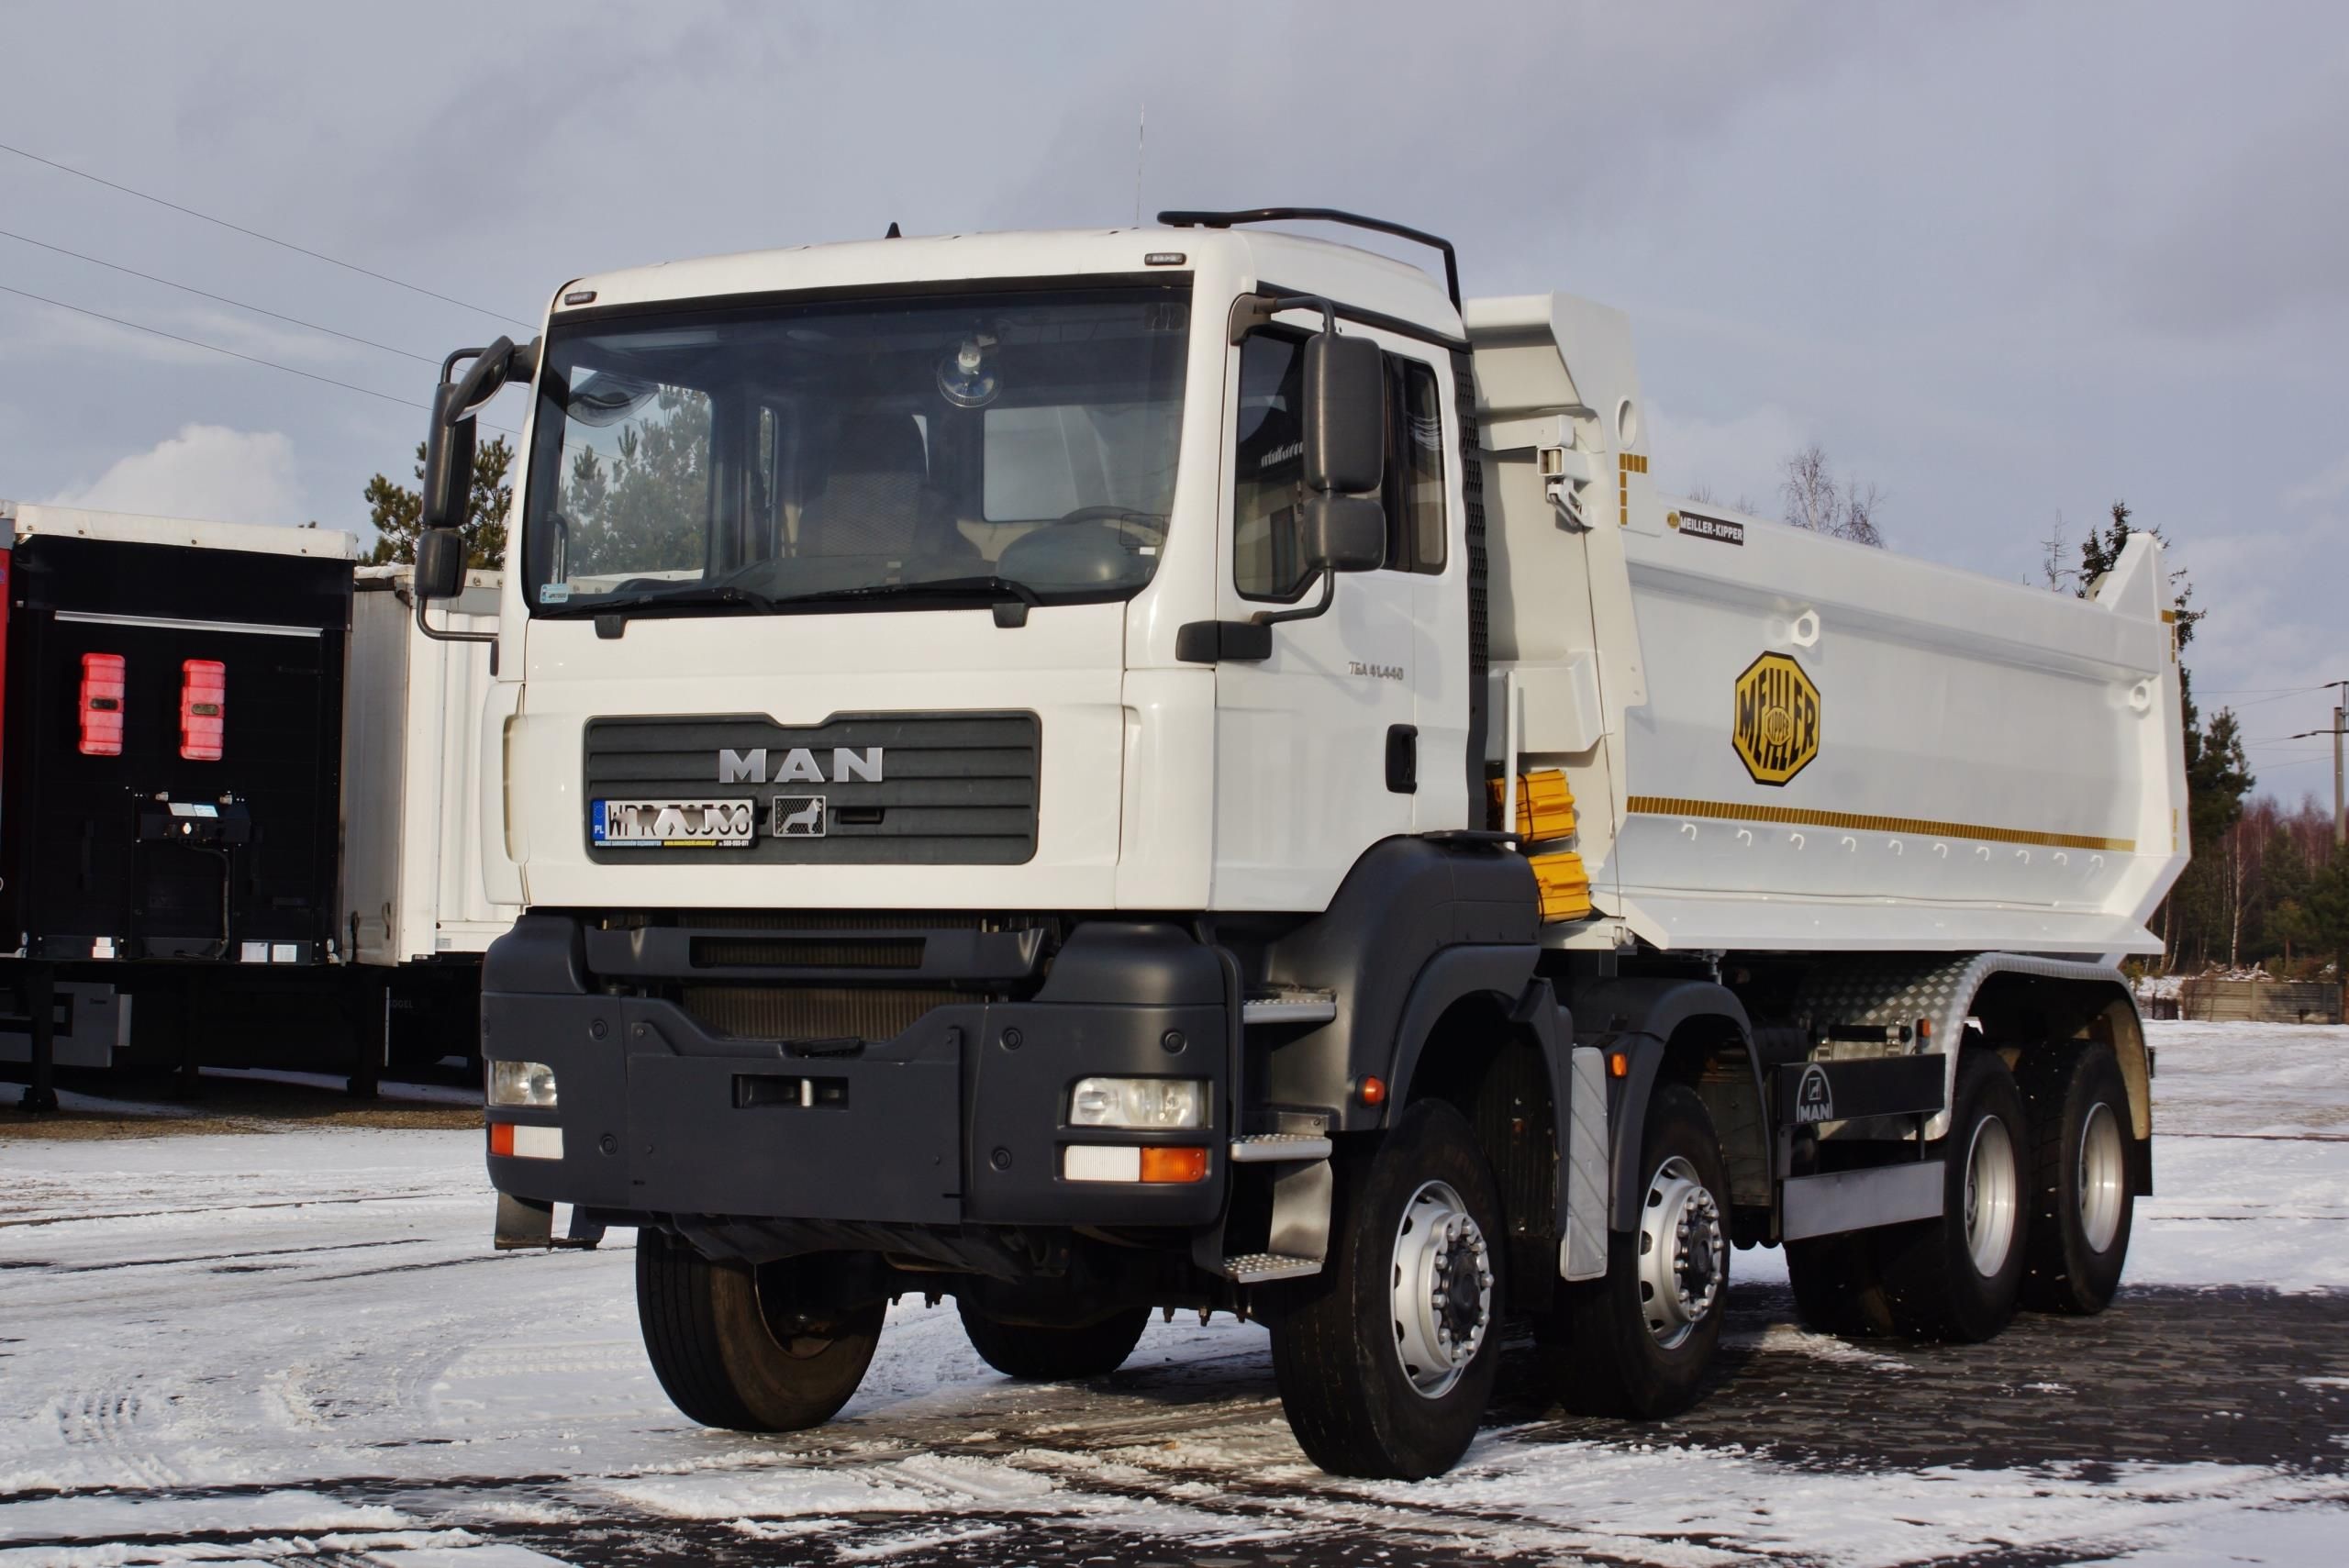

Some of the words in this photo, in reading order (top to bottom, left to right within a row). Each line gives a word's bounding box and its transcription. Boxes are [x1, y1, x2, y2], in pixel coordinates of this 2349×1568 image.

[1679, 515, 1743, 541] MEILLER-KIPPER
[1738, 667, 1816, 772] MEILLER
[718, 747, 884, 784] MAN
[594, 824, 605, 835] PL
[1799, 1103, 1830, 1123] MAN
